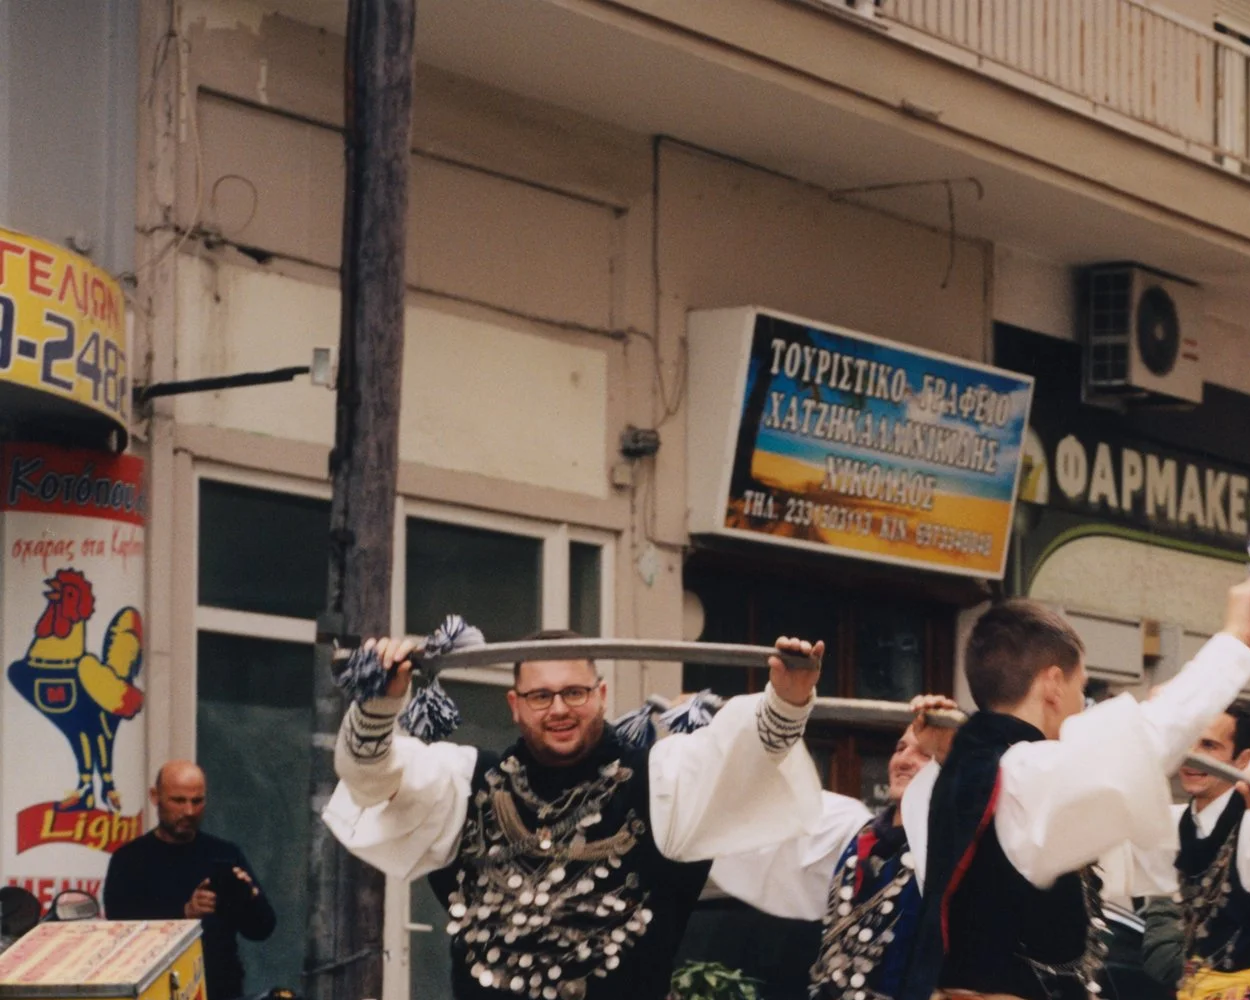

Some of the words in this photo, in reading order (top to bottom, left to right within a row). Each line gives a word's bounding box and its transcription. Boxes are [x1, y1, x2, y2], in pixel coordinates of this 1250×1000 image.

[769, 338, 908, 403] ΤΟΥΡΙΣΤΙΚΟ
[821, 455, 937, 510] ΝΙΚΟΛΑΟΣ
[40, 808, 139, 850] Light
